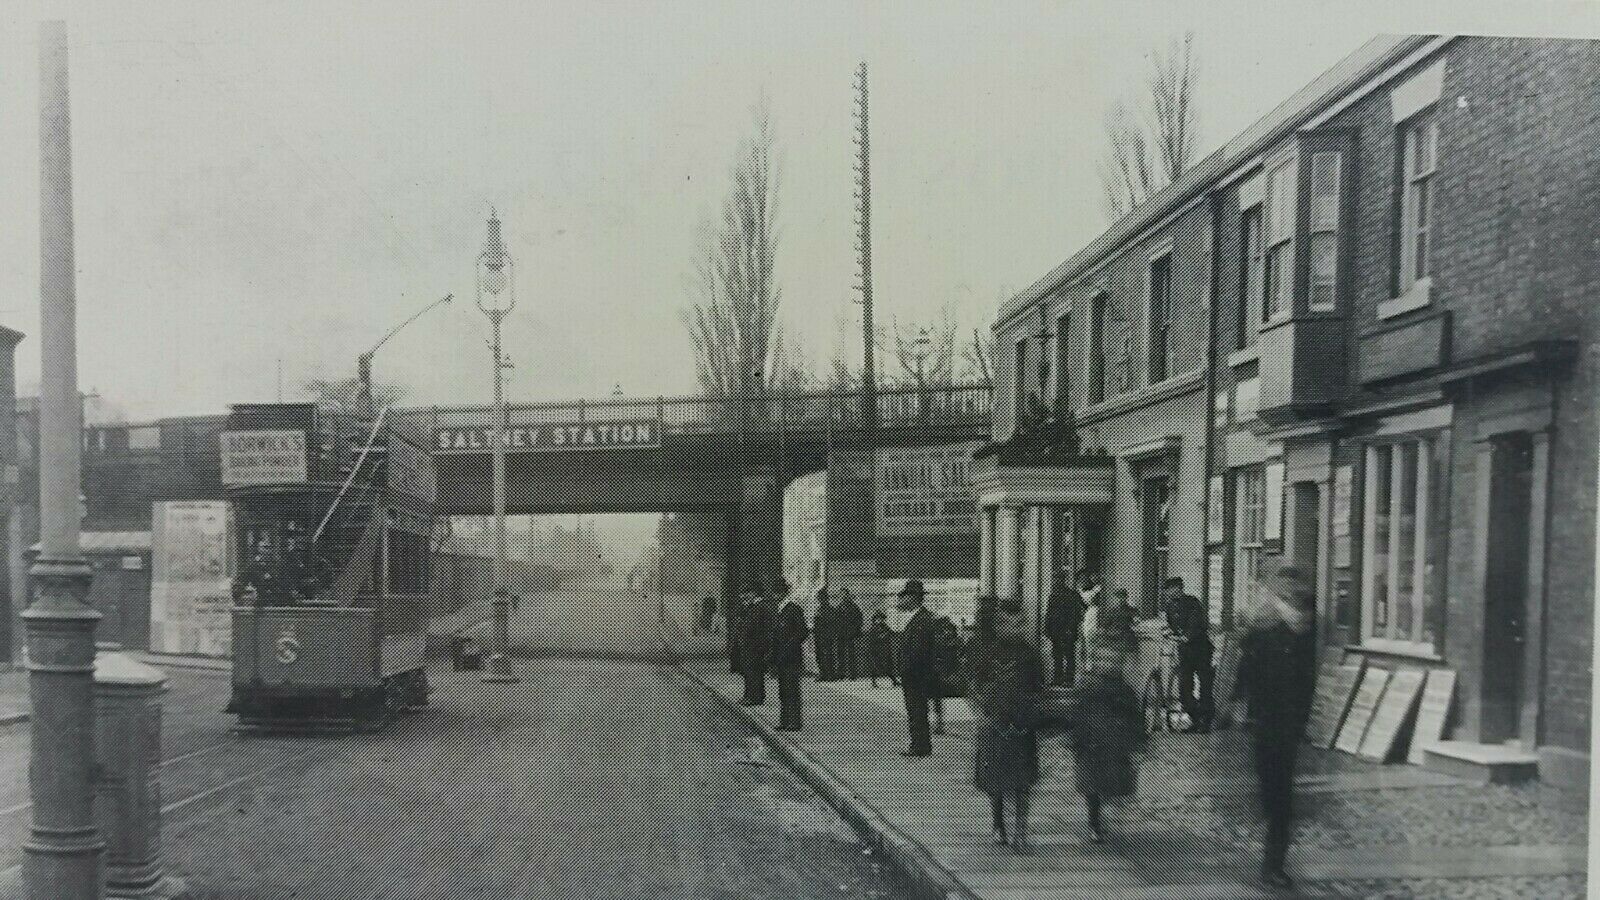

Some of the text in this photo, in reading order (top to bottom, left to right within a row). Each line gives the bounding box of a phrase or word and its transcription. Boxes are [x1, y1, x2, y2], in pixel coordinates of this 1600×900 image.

[439, 424, 650, 448] SALTNEY STATION
[884, 463, 936, 490] ANNUAL
